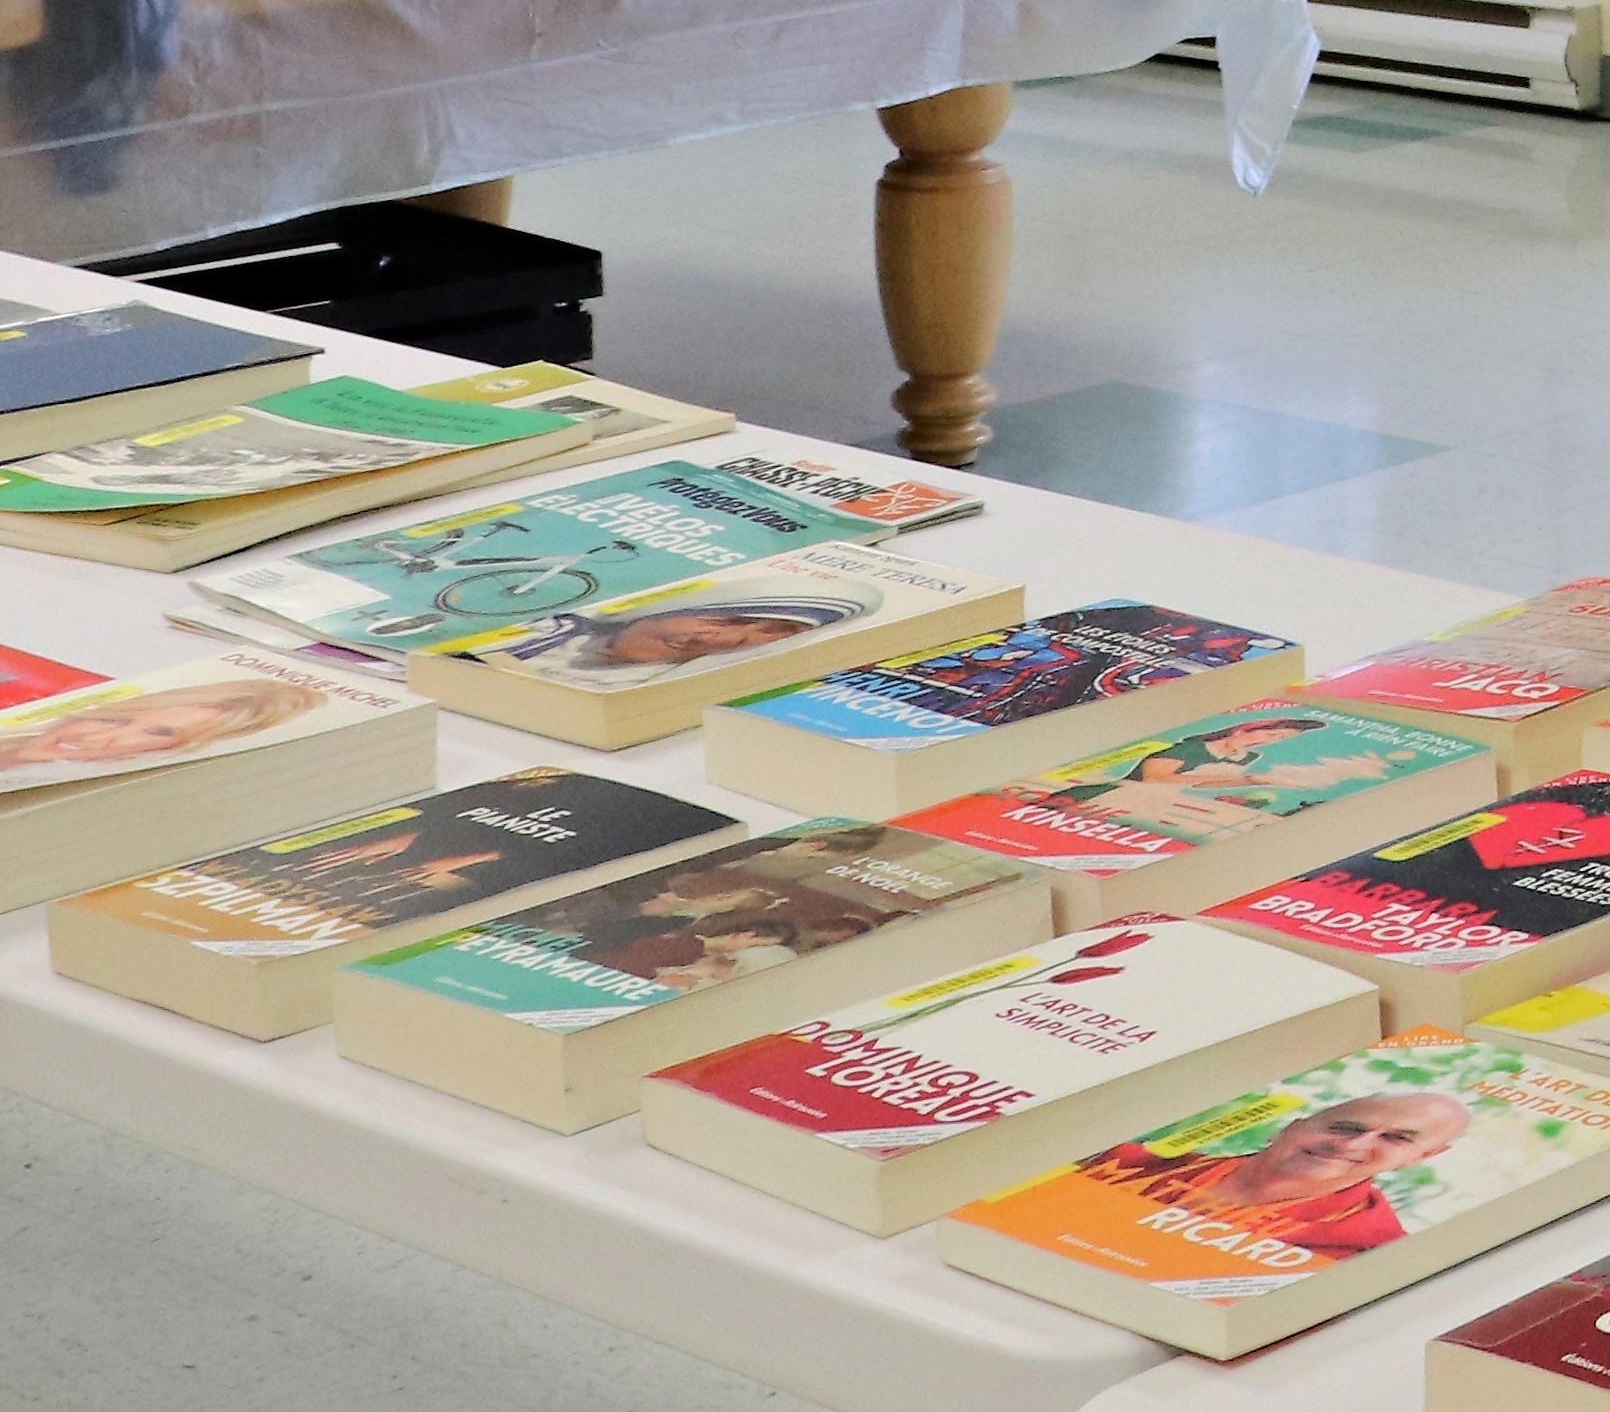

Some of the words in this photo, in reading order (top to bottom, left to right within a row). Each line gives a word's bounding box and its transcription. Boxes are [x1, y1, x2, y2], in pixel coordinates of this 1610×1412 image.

[526, 494, 746, 566] ÉLECTRIQUES
[220, 653, 338, 690] DOMINIQUE
[332, 687, 401, 709] MICHEL
[1432, 673, 1560, 699] JACQ
[455, 806, 579, 845] PIANISTE
[526, 806, 573, 822] LE
[1000, 804, 1173, 853] KINSELLA
[825, 863, 860, 879] DE
[1310, 869, 1498, 927] BARBARA
[133, 870, 364, 940] SZPILMAN
[1248, 894, 1467, 953] BRADFORD
[1370, 902, 1530, 950] TAYLOR
[436, 930, 671, 1002] PEYRAMAURE
[994, 1007, 1136, 1055] SIMPLICITÉ
[1018, 991, 1093, 1018] L'ART
[1081, 1011, 1127, 1031] DE
[1115, 1024, 1157, 1044] LA
[785, 1019, 1037, 1117] DOMINIQUE
[804, 1052, 992, 1123] LOREAU
[1510, 1067, 1588, 1095] L'ART
[1136, 1206, 1315, 1269] RICARD
